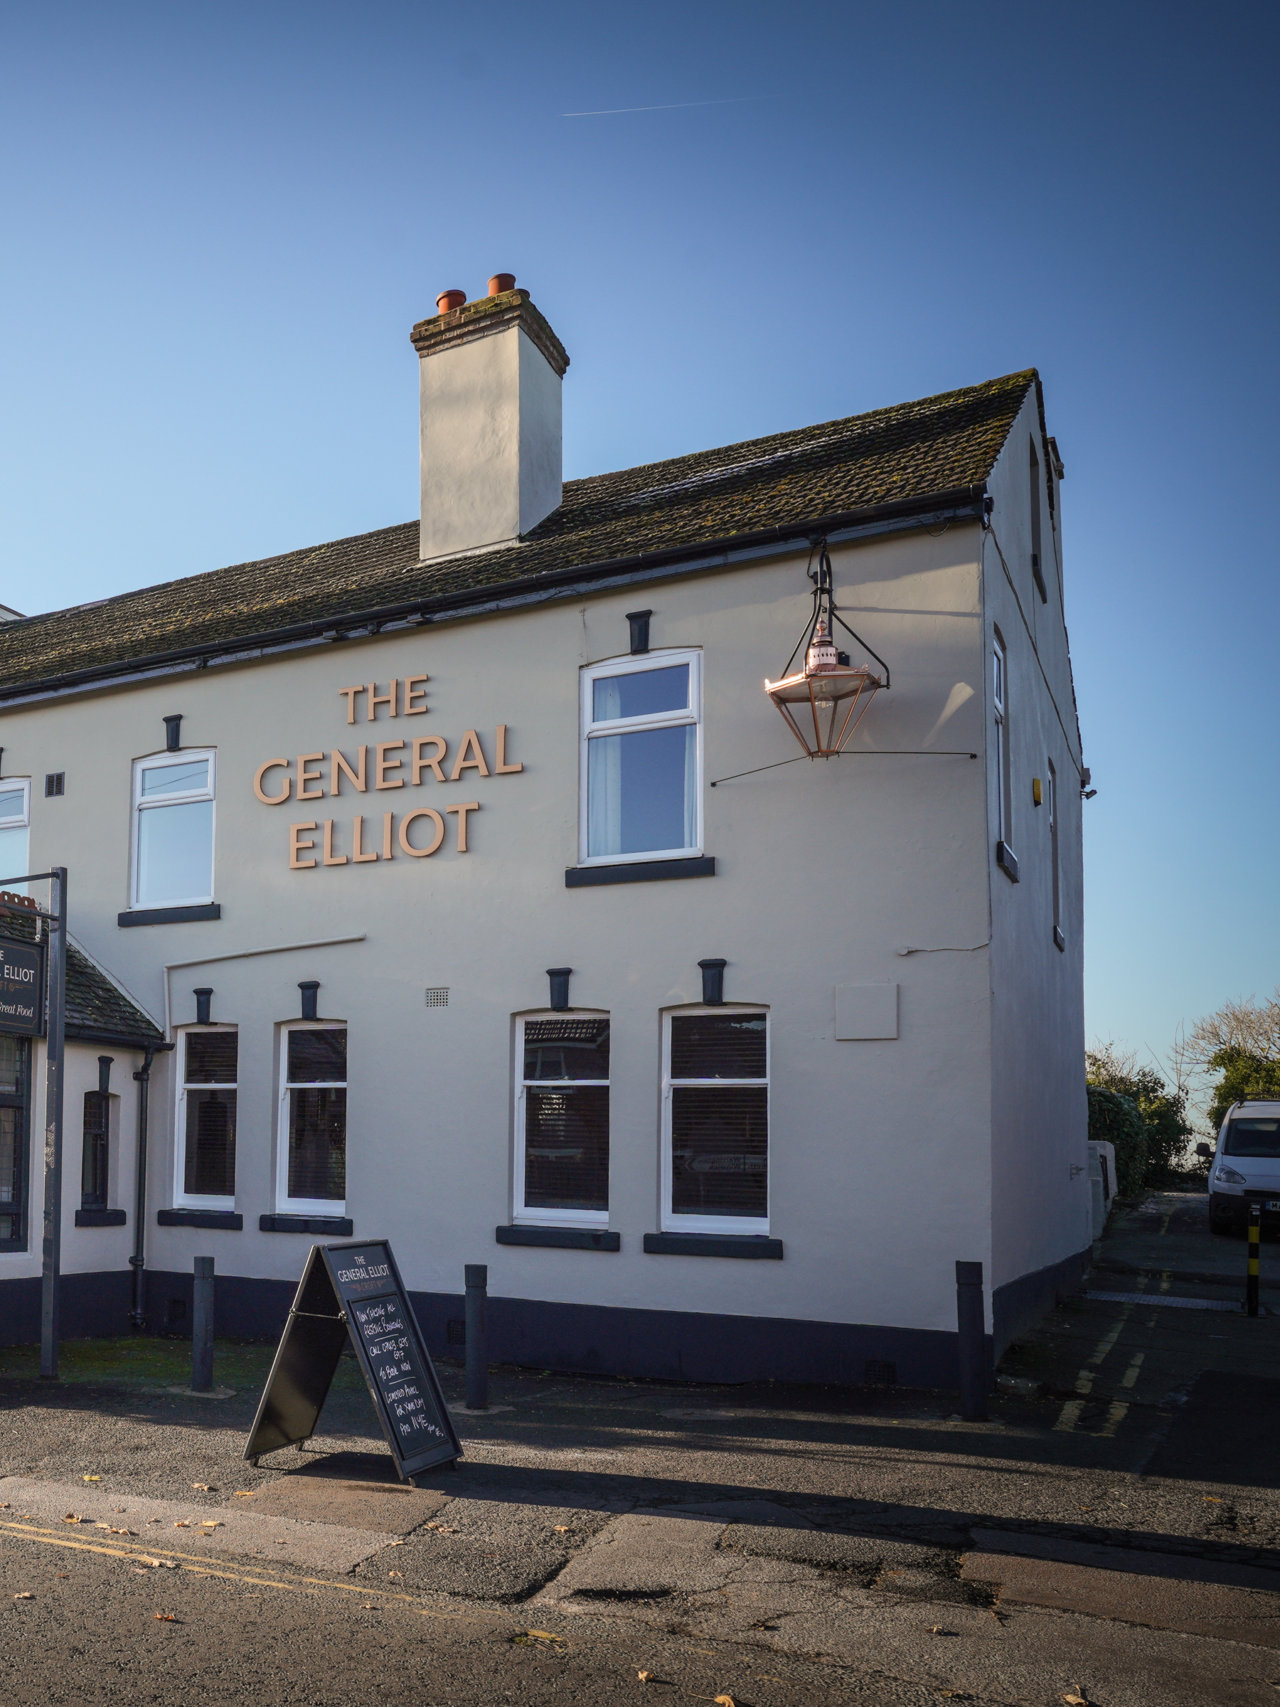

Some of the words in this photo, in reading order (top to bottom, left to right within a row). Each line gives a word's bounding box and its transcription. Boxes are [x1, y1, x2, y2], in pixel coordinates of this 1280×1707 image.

[338, 674, 429, 725] THE
[253, 724, 524, 806] GENERAL
[288, 801, 480, 870] ELLIOT
[3, 964, 35, 983] ELLIOT
[16, 1004, 34, 1018] Food
[354, 1255, 366, 1265] THE
[337, 1267, 369, 1282] GENERAL
[368, 1264, 390, 1278] ELLIOT
